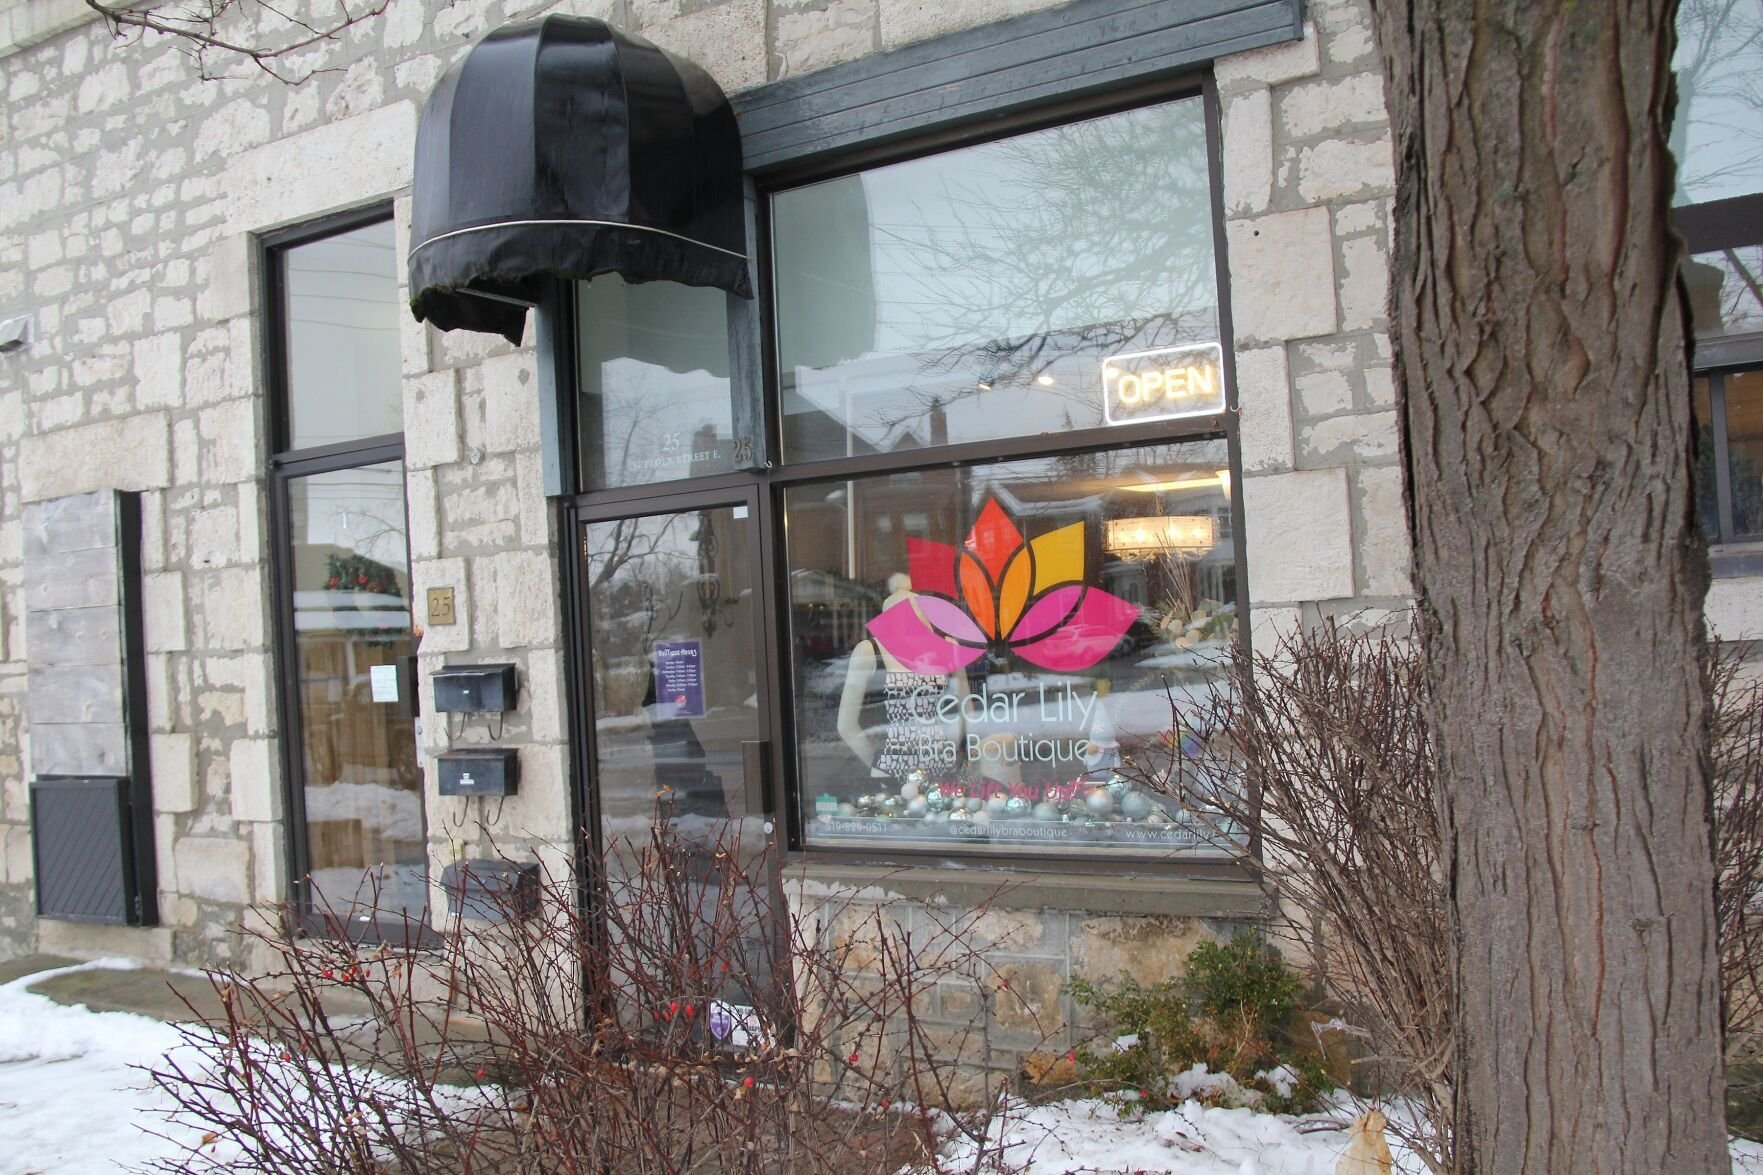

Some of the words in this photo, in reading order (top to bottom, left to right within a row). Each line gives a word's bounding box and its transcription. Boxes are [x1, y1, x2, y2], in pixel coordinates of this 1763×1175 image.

[1118, 364, 1214, 403] OPEN
[662, 432, 680, 451] 25
[731, 436, 753, 462] 25
[676, 451, 710, 463] STREET
[713, 449, 721, 459] E.
[431, 596, 451, 617] 25
[911, 682, 1026, 724] Cedar
[1039, 680, 1098, 731] Lily
[919, 735, 957, 761] Bra
[966, 733, 1091, 768] Boutique
[1008, 781, 1041, 800] You
